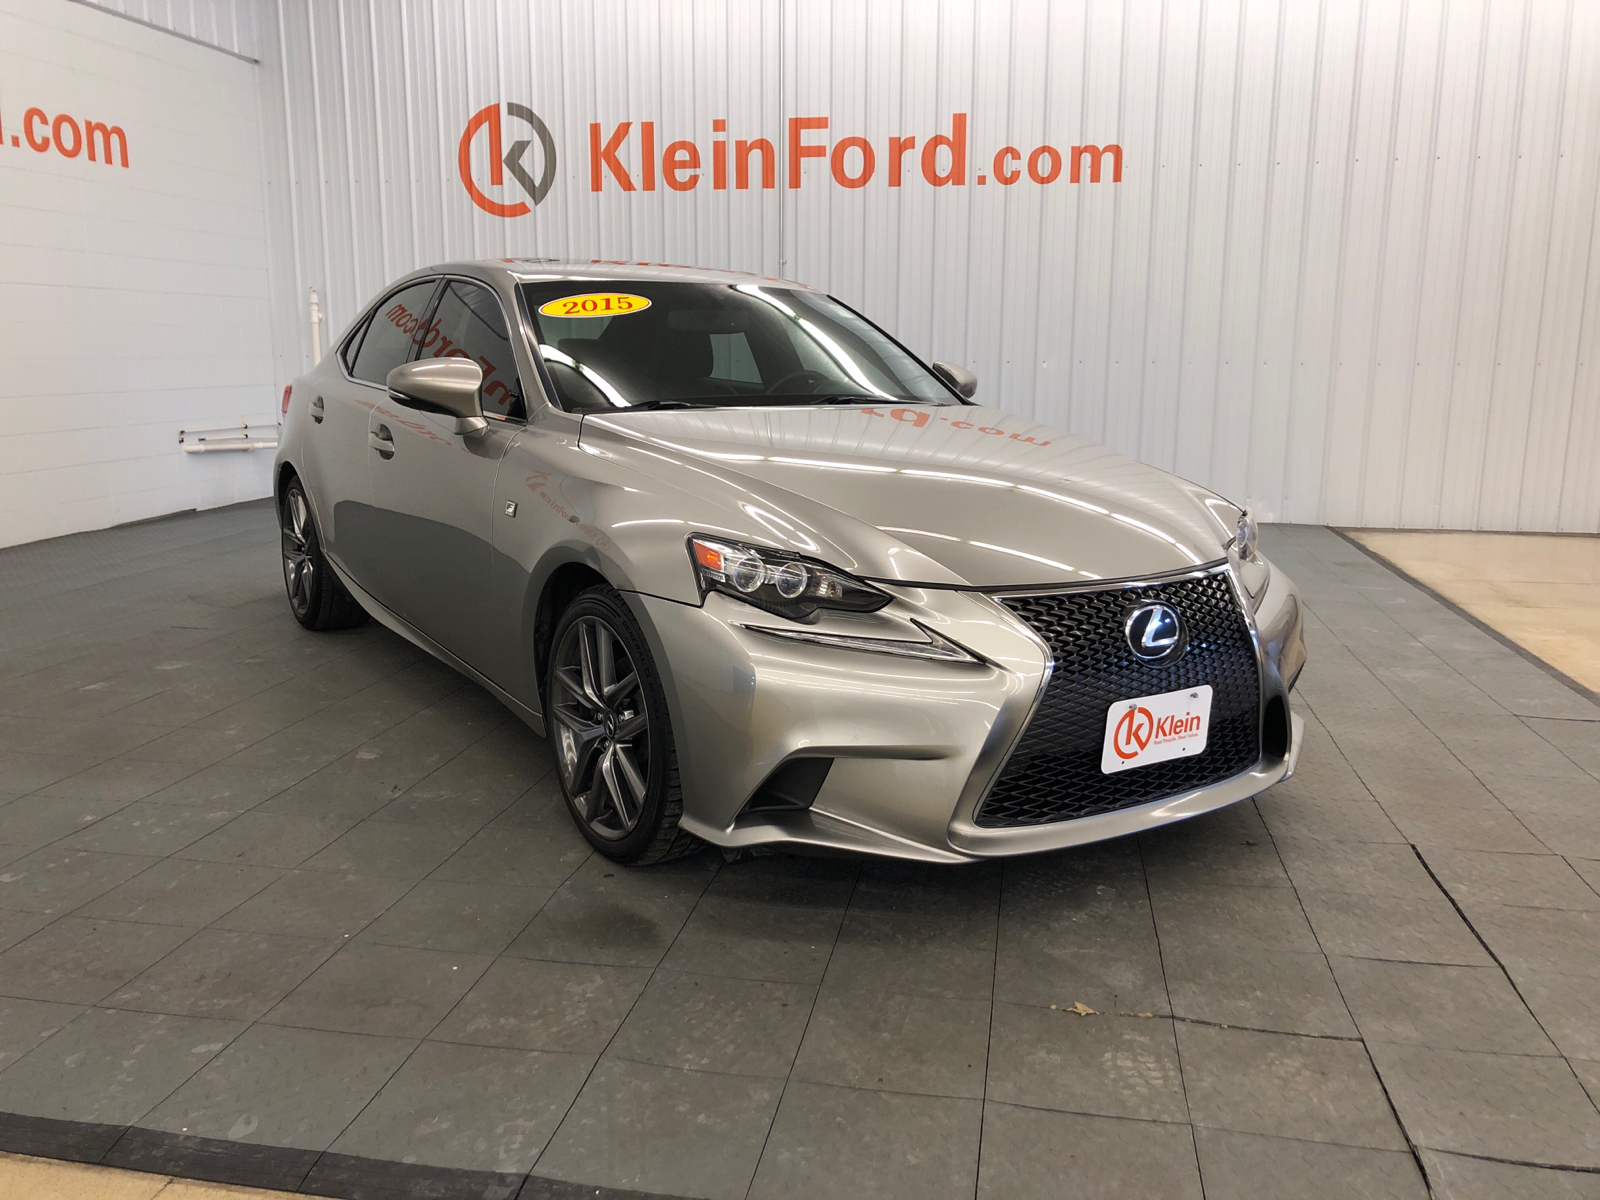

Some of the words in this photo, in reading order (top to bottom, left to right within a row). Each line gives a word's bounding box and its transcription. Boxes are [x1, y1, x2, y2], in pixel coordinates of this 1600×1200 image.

[0, 106, 129, 169] .com
[590, 112, 1123, 192] KleinFord.com
[562, 297, 633, 315] 2015
[621, 620, 646, 665] GENERAL
[1154, 711, 1201, 739] Klein
